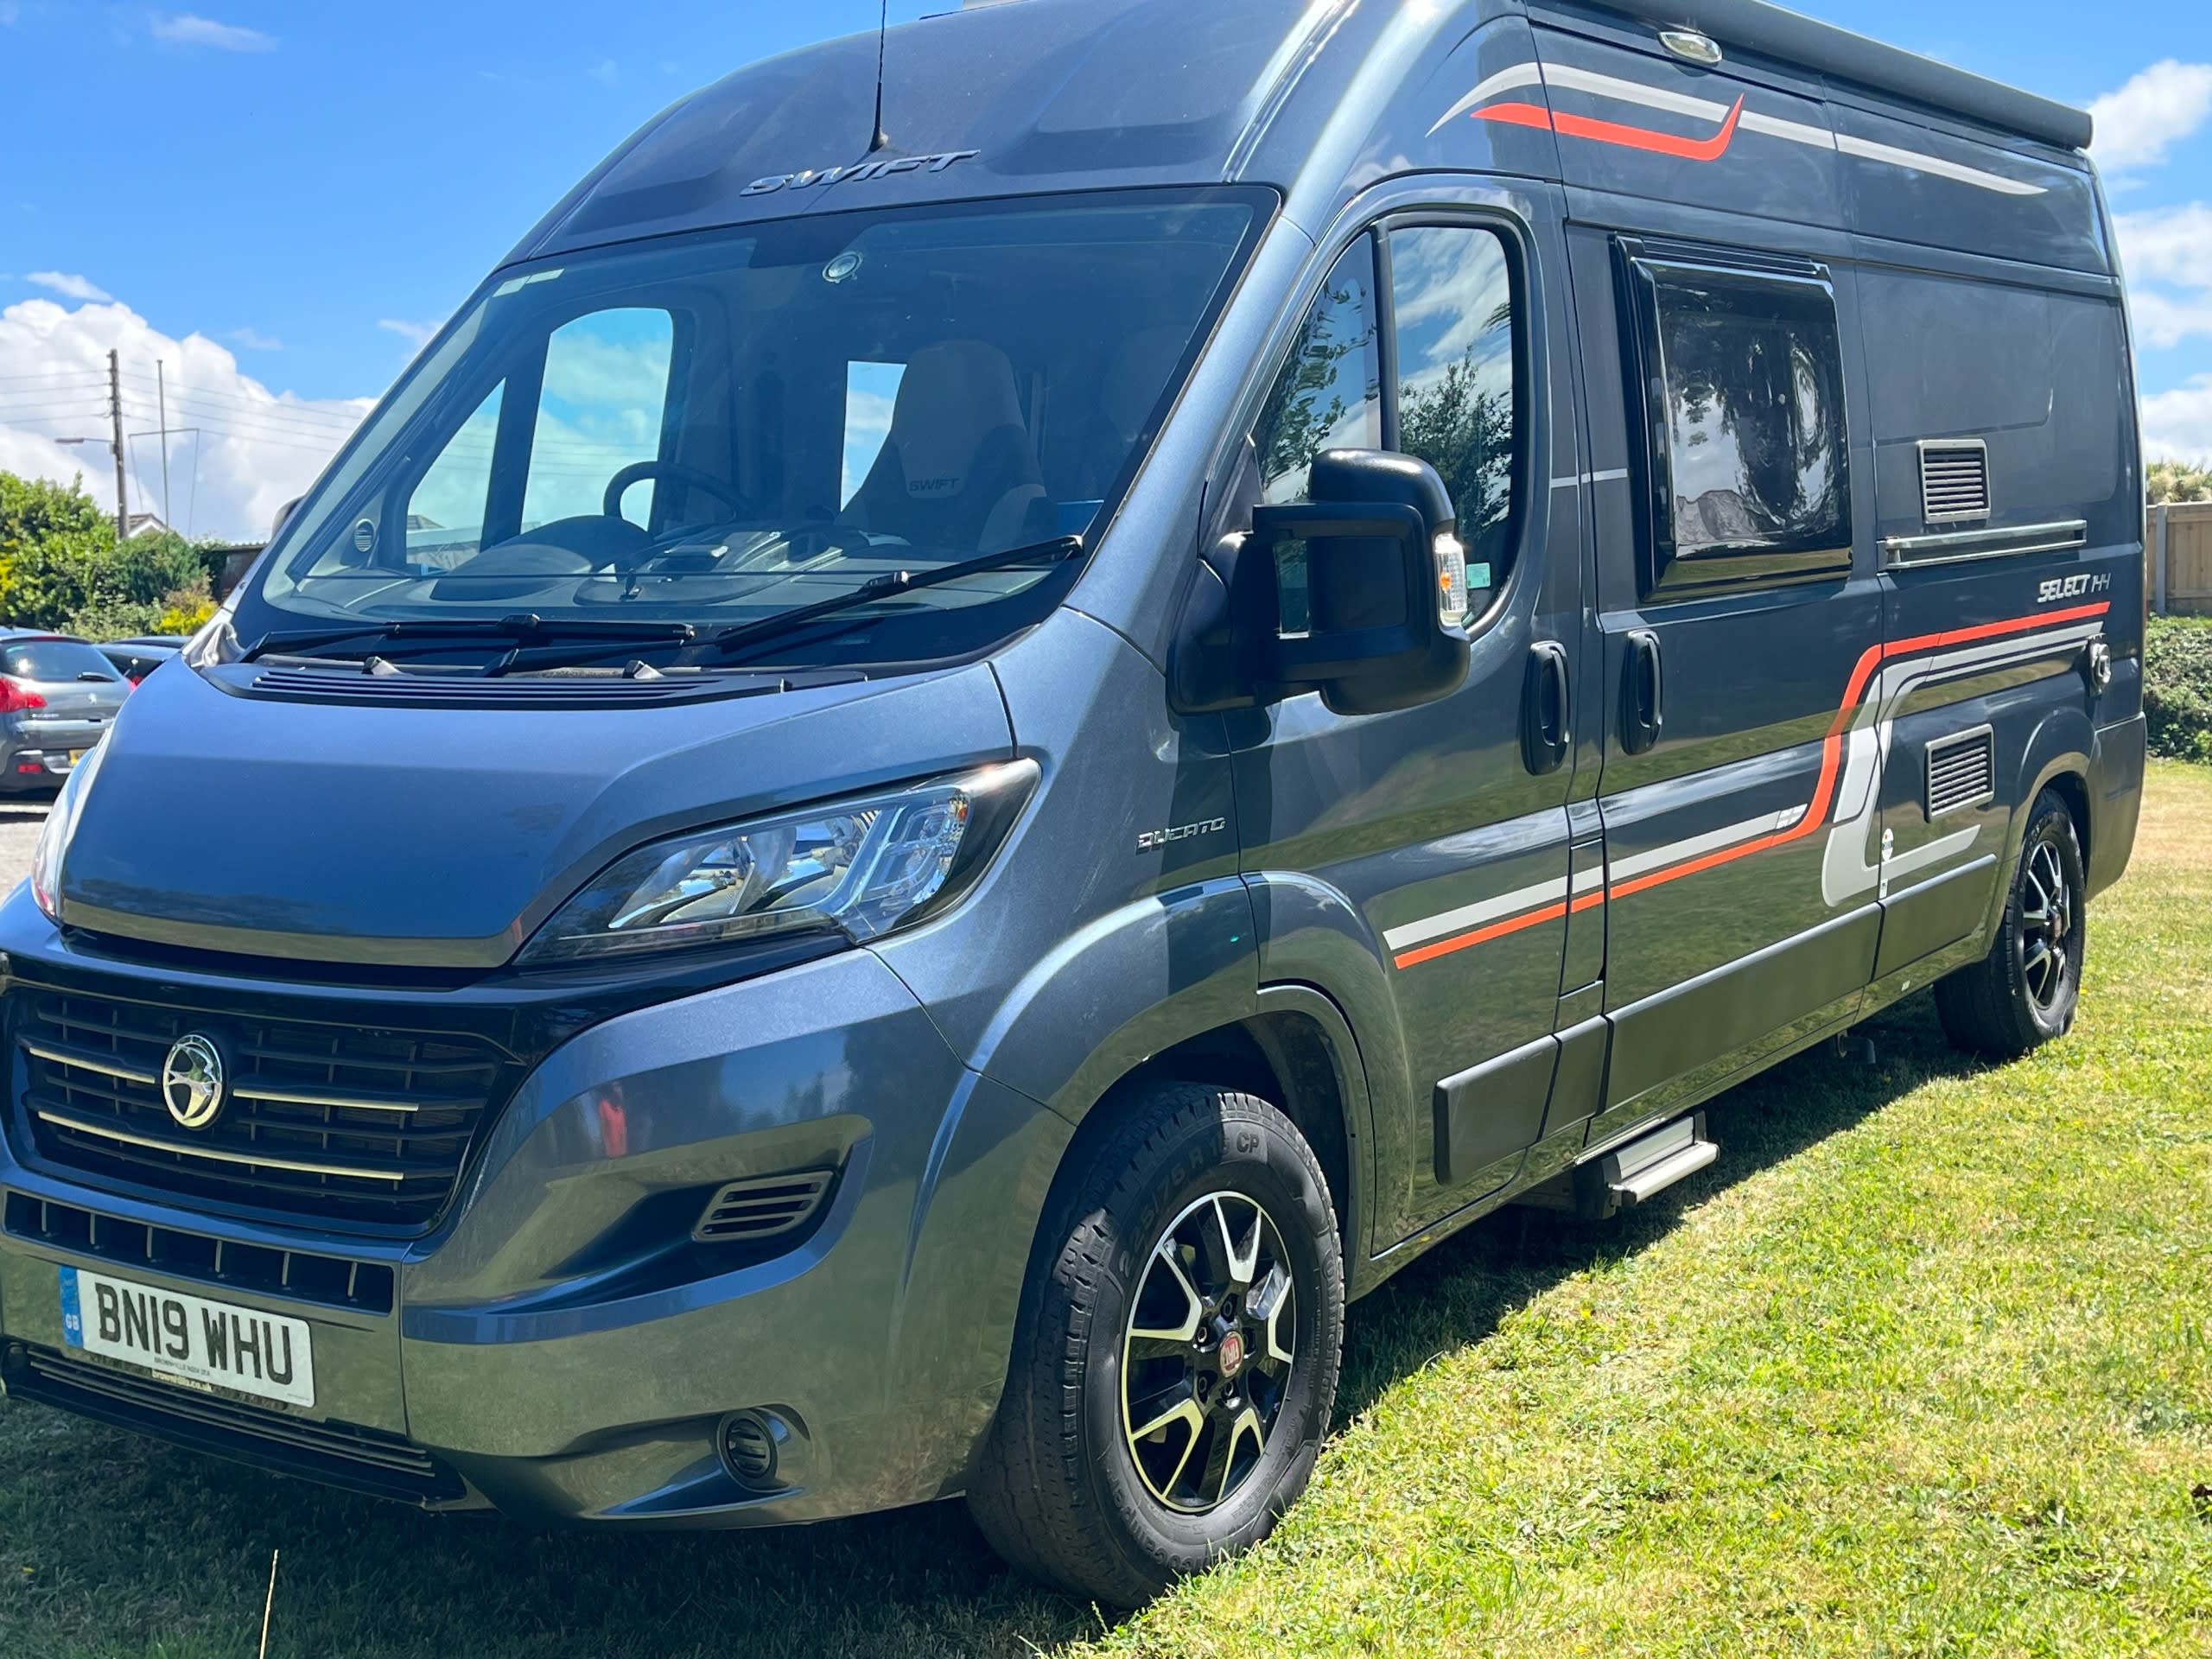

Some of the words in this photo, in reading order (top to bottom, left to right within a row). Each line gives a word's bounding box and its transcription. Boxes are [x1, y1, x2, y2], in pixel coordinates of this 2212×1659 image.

[740, 149, 982, 197] SWIFT
[909, 477, 960, 492] SWIFT
[2037, 574, 2091, 603] SELECT
[1137, 817, 1226, 849] DUCATO
[1236, 1131, 1259, 1154] CP
[66, 1313, 79, 1331] GB
[95, 1282, 189, 1361] BN19
[201, 1307, 293, 1385] WHU
